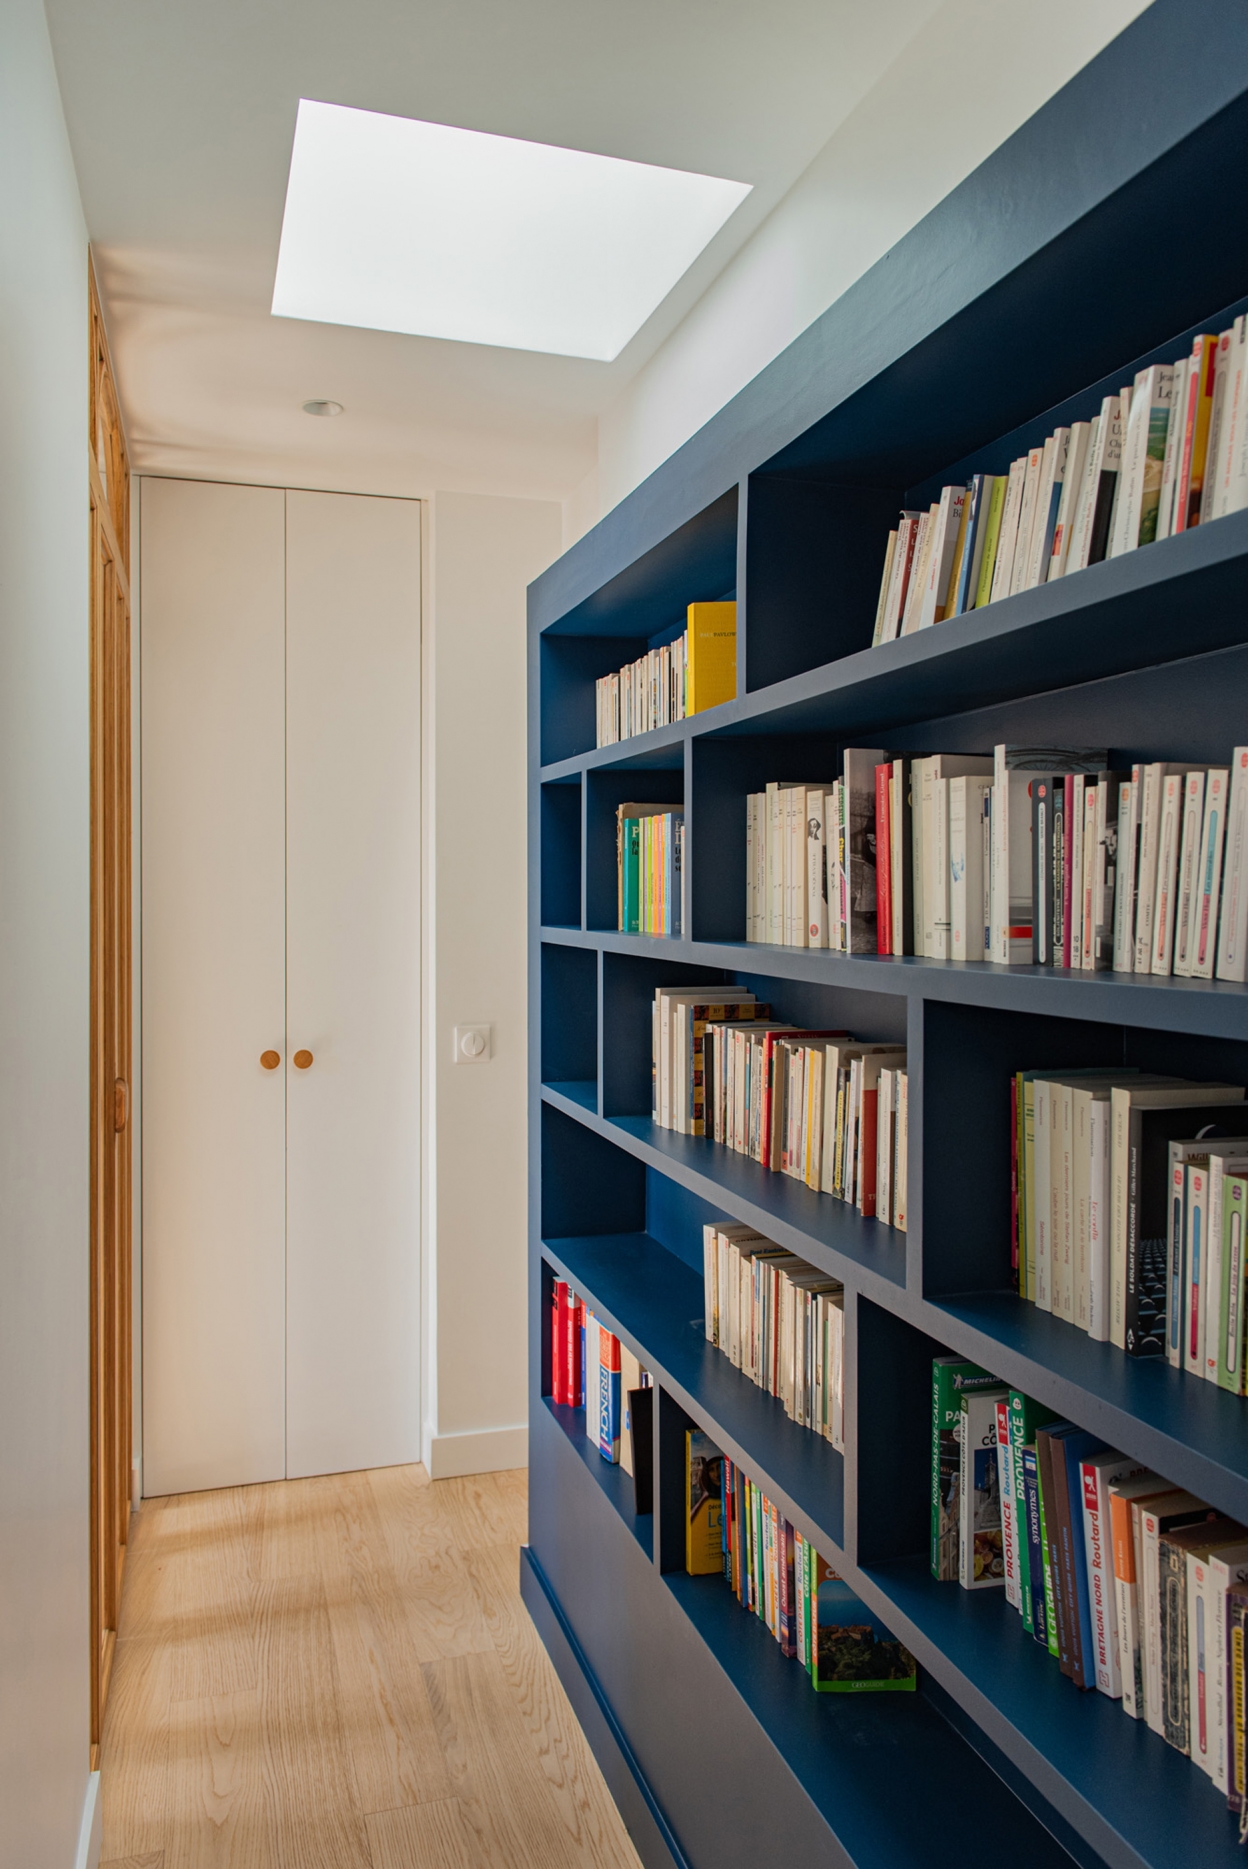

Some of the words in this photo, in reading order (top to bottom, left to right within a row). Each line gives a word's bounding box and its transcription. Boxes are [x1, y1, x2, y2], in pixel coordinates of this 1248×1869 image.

[1130, 1284, 1135, 1294] LE
[600, 1368, 610, 1442] FRENCH
[1000, 1445, 1010, 1496] Routard
[1012, 1416, 1026, 1500] PROVENCE
[1003, 1500, 1014, 1580] PROVENCE
[1029, 1489, 1040, 1545] synonymes
[1089, 1510, 1102, 1570] Routard
[1094, 1574, 1103, 1607] NORD
[1096, 1609, 1107, 1666] BRETAGNE
